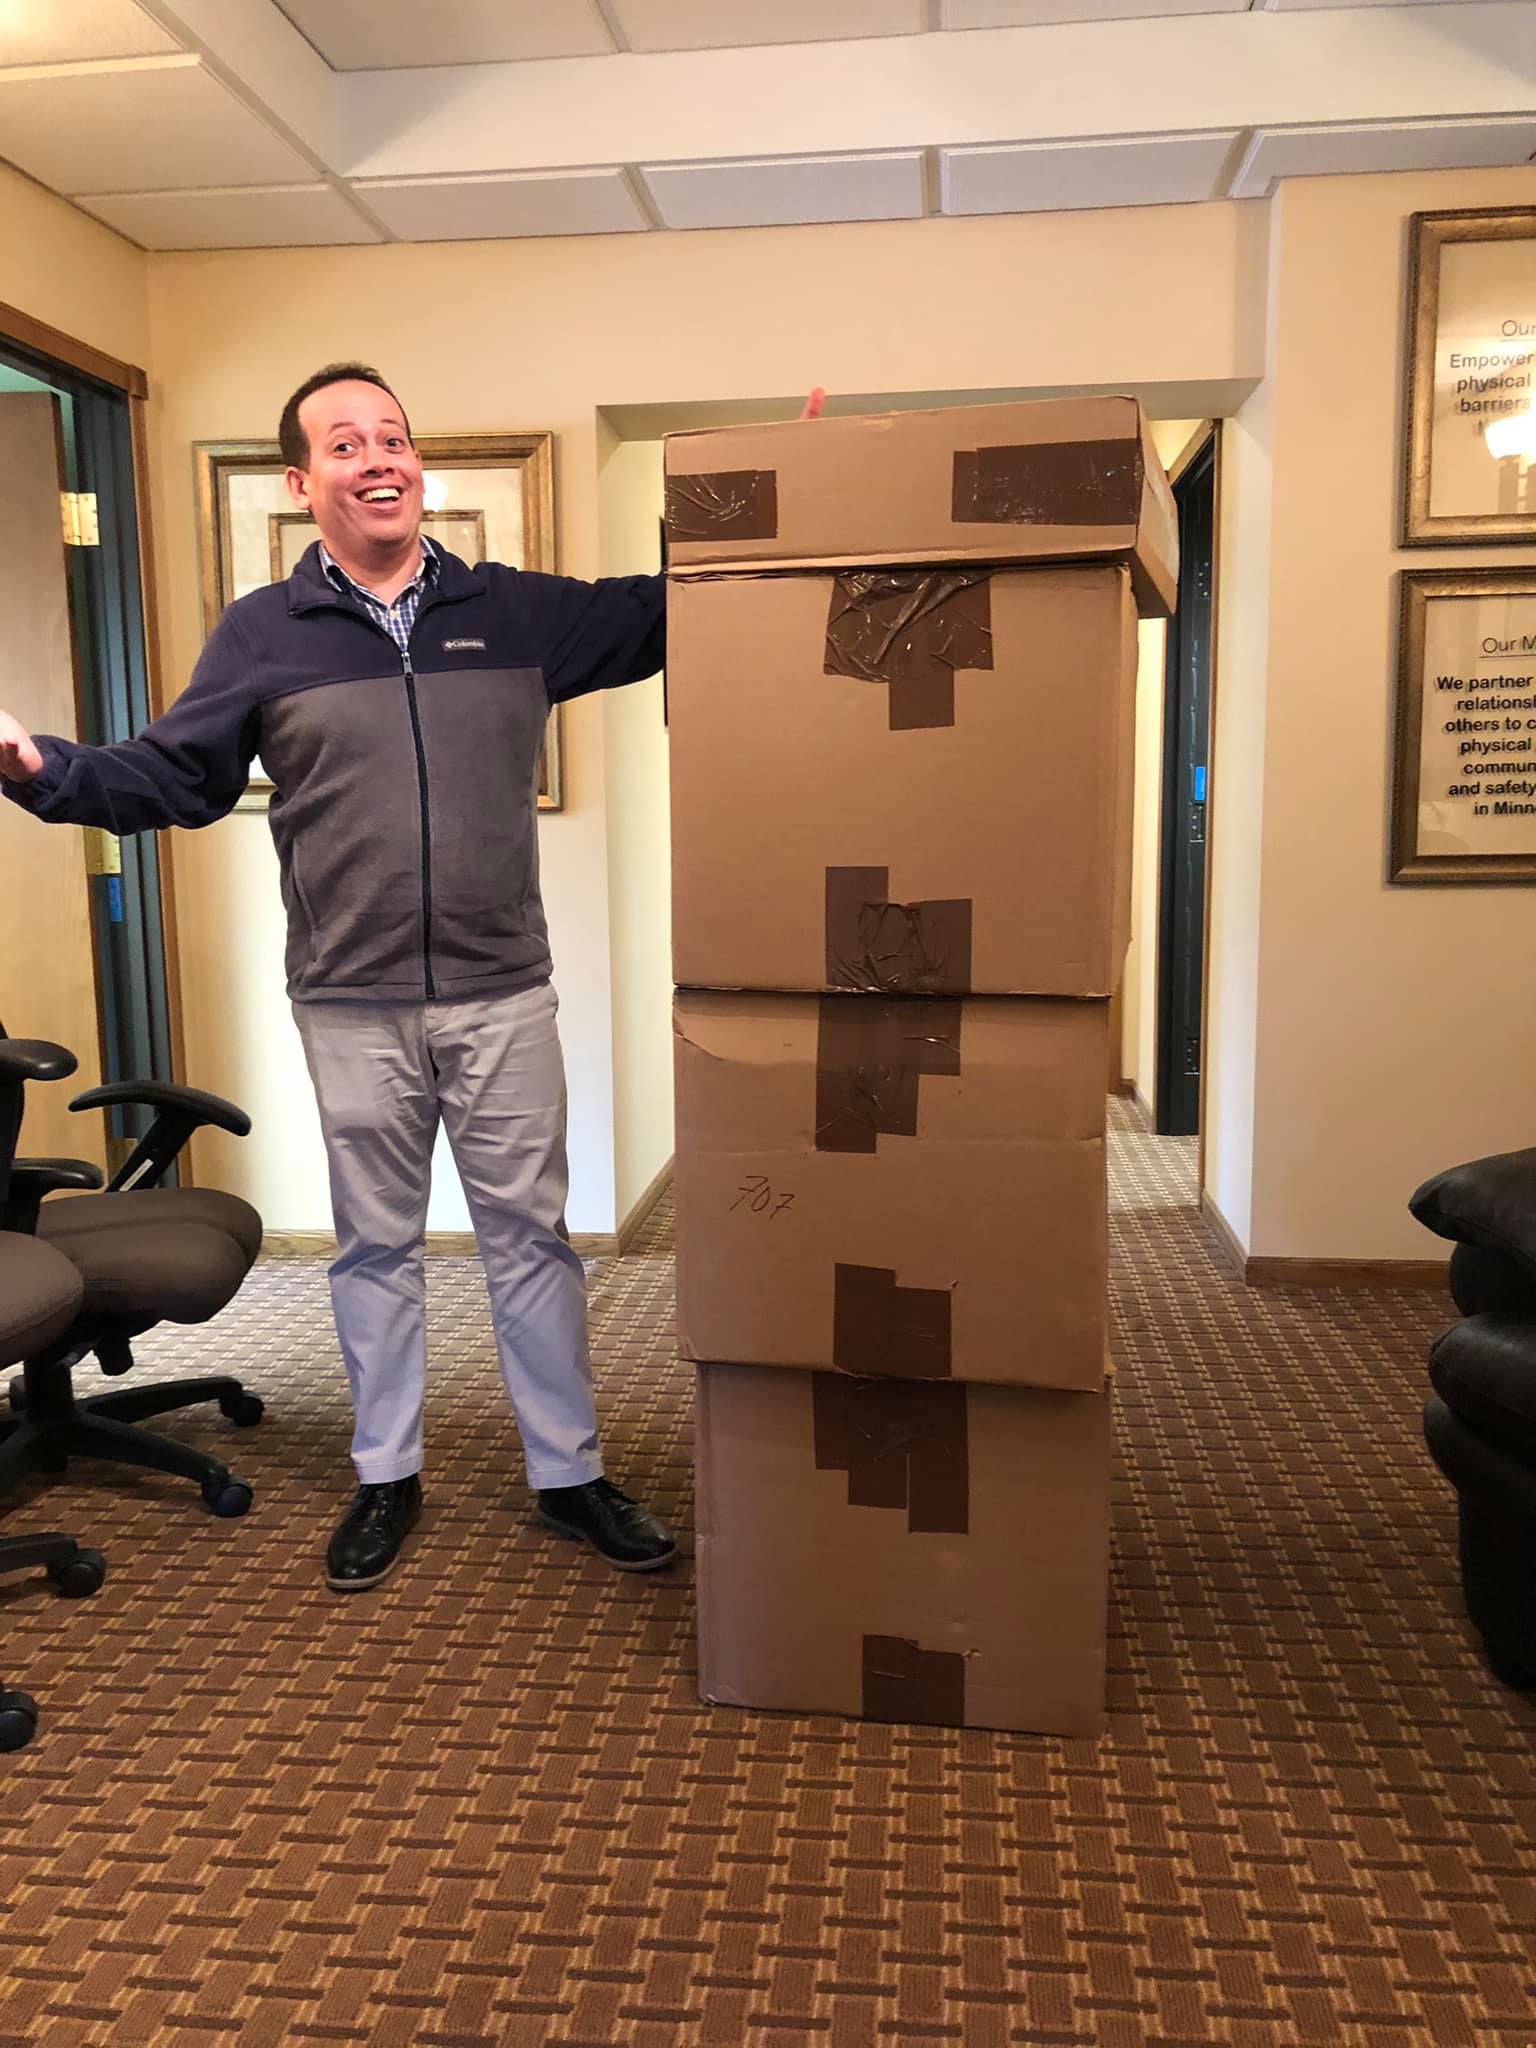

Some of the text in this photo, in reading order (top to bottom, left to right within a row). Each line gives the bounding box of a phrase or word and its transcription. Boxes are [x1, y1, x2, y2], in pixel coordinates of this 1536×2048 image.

[1456, 373, 1531, 393] physical
[1460, 397, 1531, 413] barriers
[1482, 637, 1517, 654] Our
[1436, 675, 1534, 693] We partner
[1445, 717, 1499, 732] others
[1505, 717, 1522, 730] to
[1460, 737, 1532, 756] physical
[1448, 780, 1536, 798] and safety
[1474, 801, 1536, 816] in Minn
[729, 1175, 794, 1219] 707
